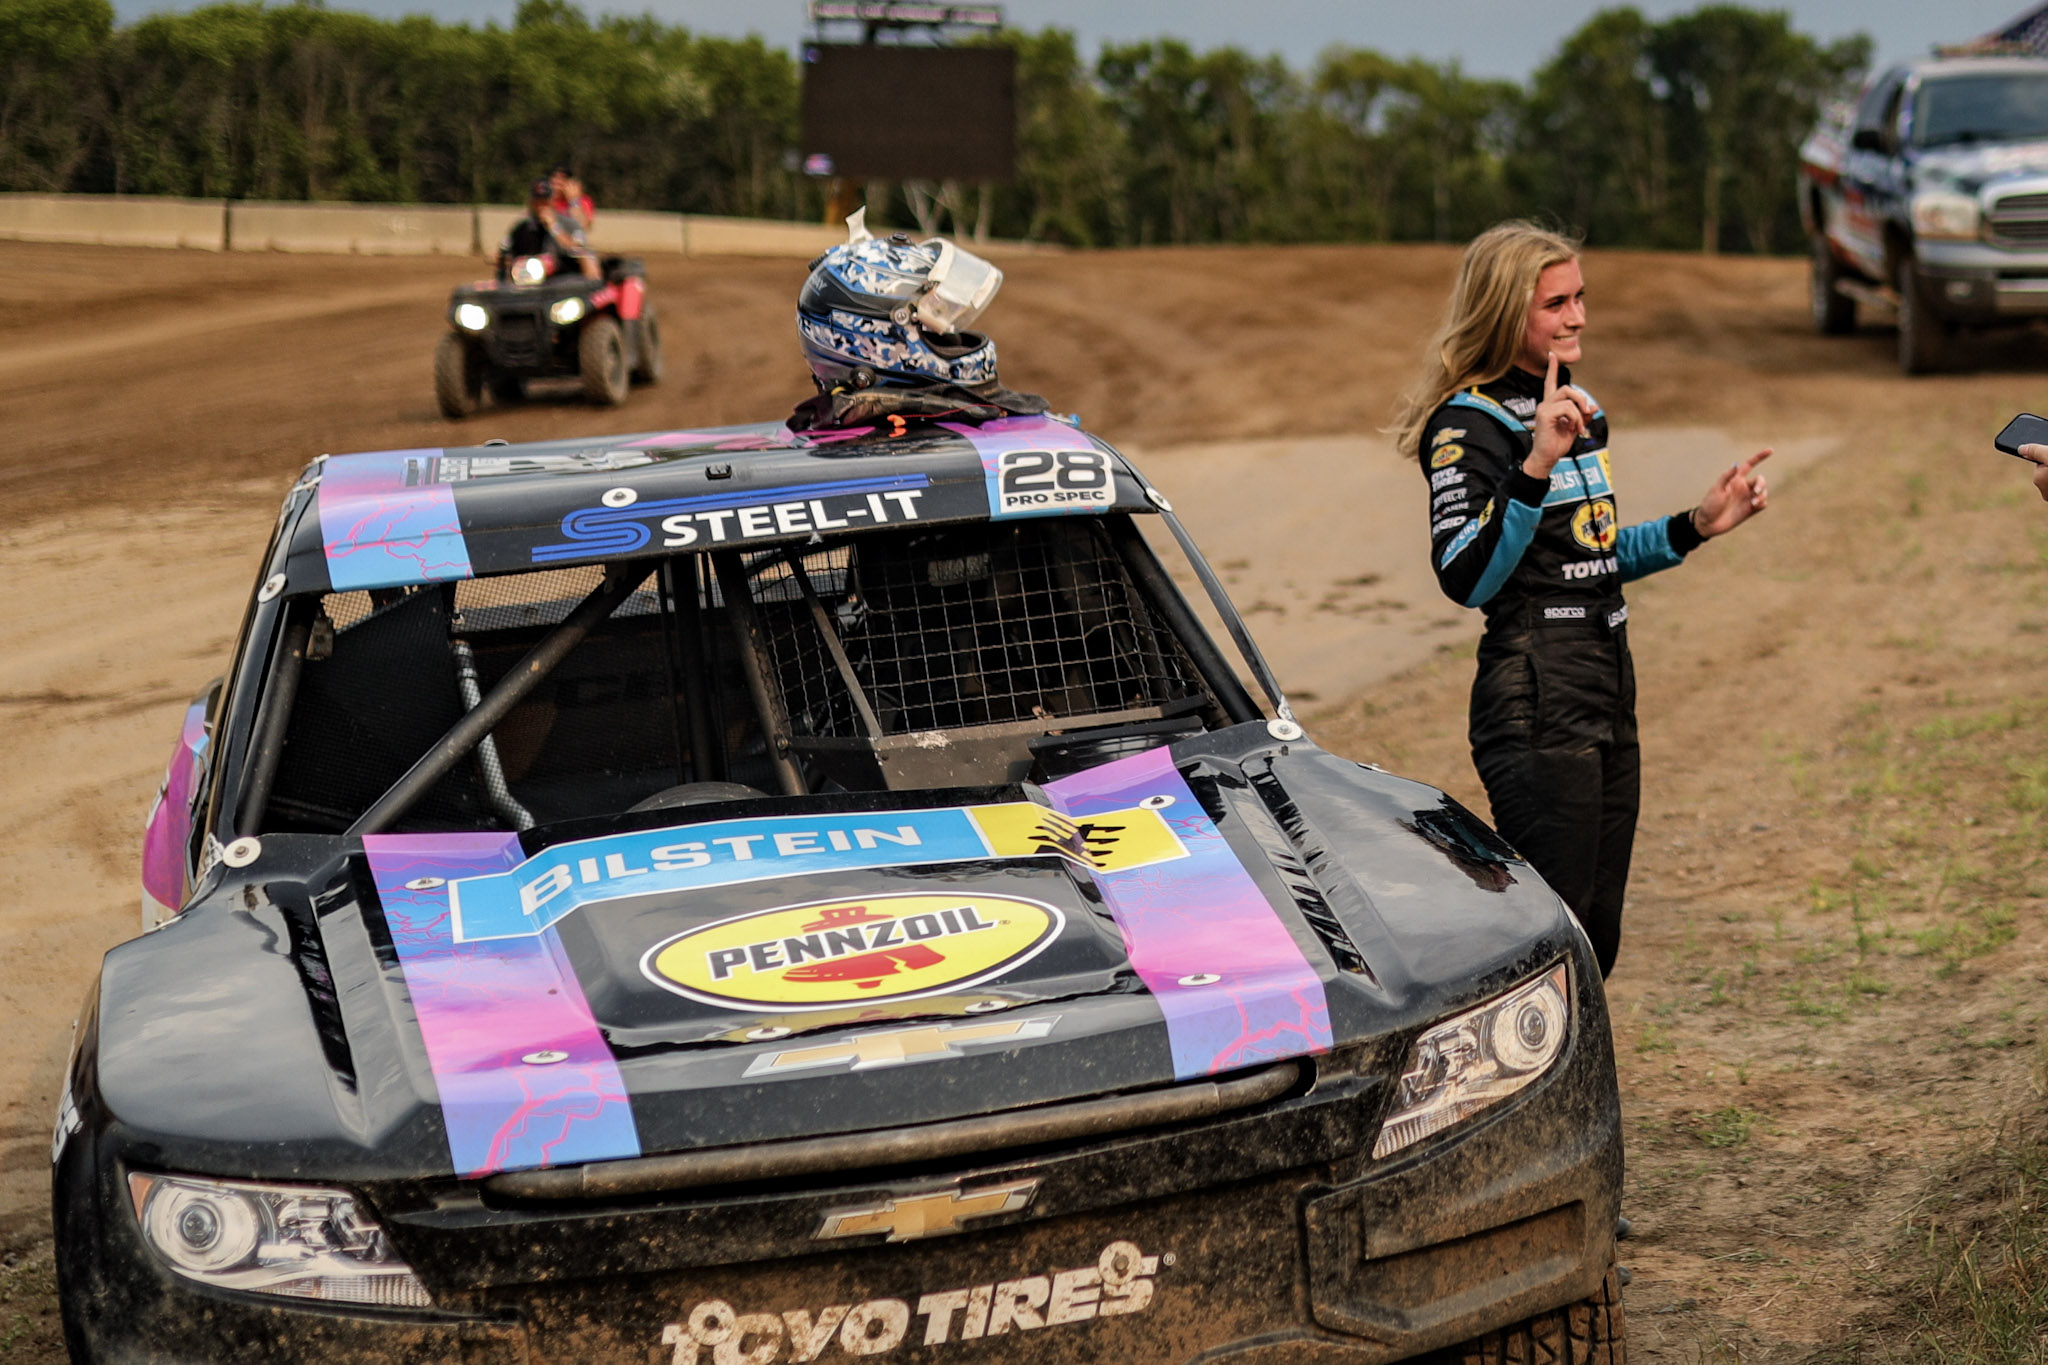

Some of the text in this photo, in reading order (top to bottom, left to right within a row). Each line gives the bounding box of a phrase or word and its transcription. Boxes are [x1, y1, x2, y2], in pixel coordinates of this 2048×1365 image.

[1004, 451, 1107, 494] 28
[1006, 490, 1106, 507] PRO SPEC
[1431, 466, 1457, 484] OYO
[661, 490, 923, 547] STEEL-IT
[519, 826, 923, 917] BILSTEIN
[707, 906, 995, 980] PENNZOIL
[661, 1253, 1159, 1365] TOYO TIRES
